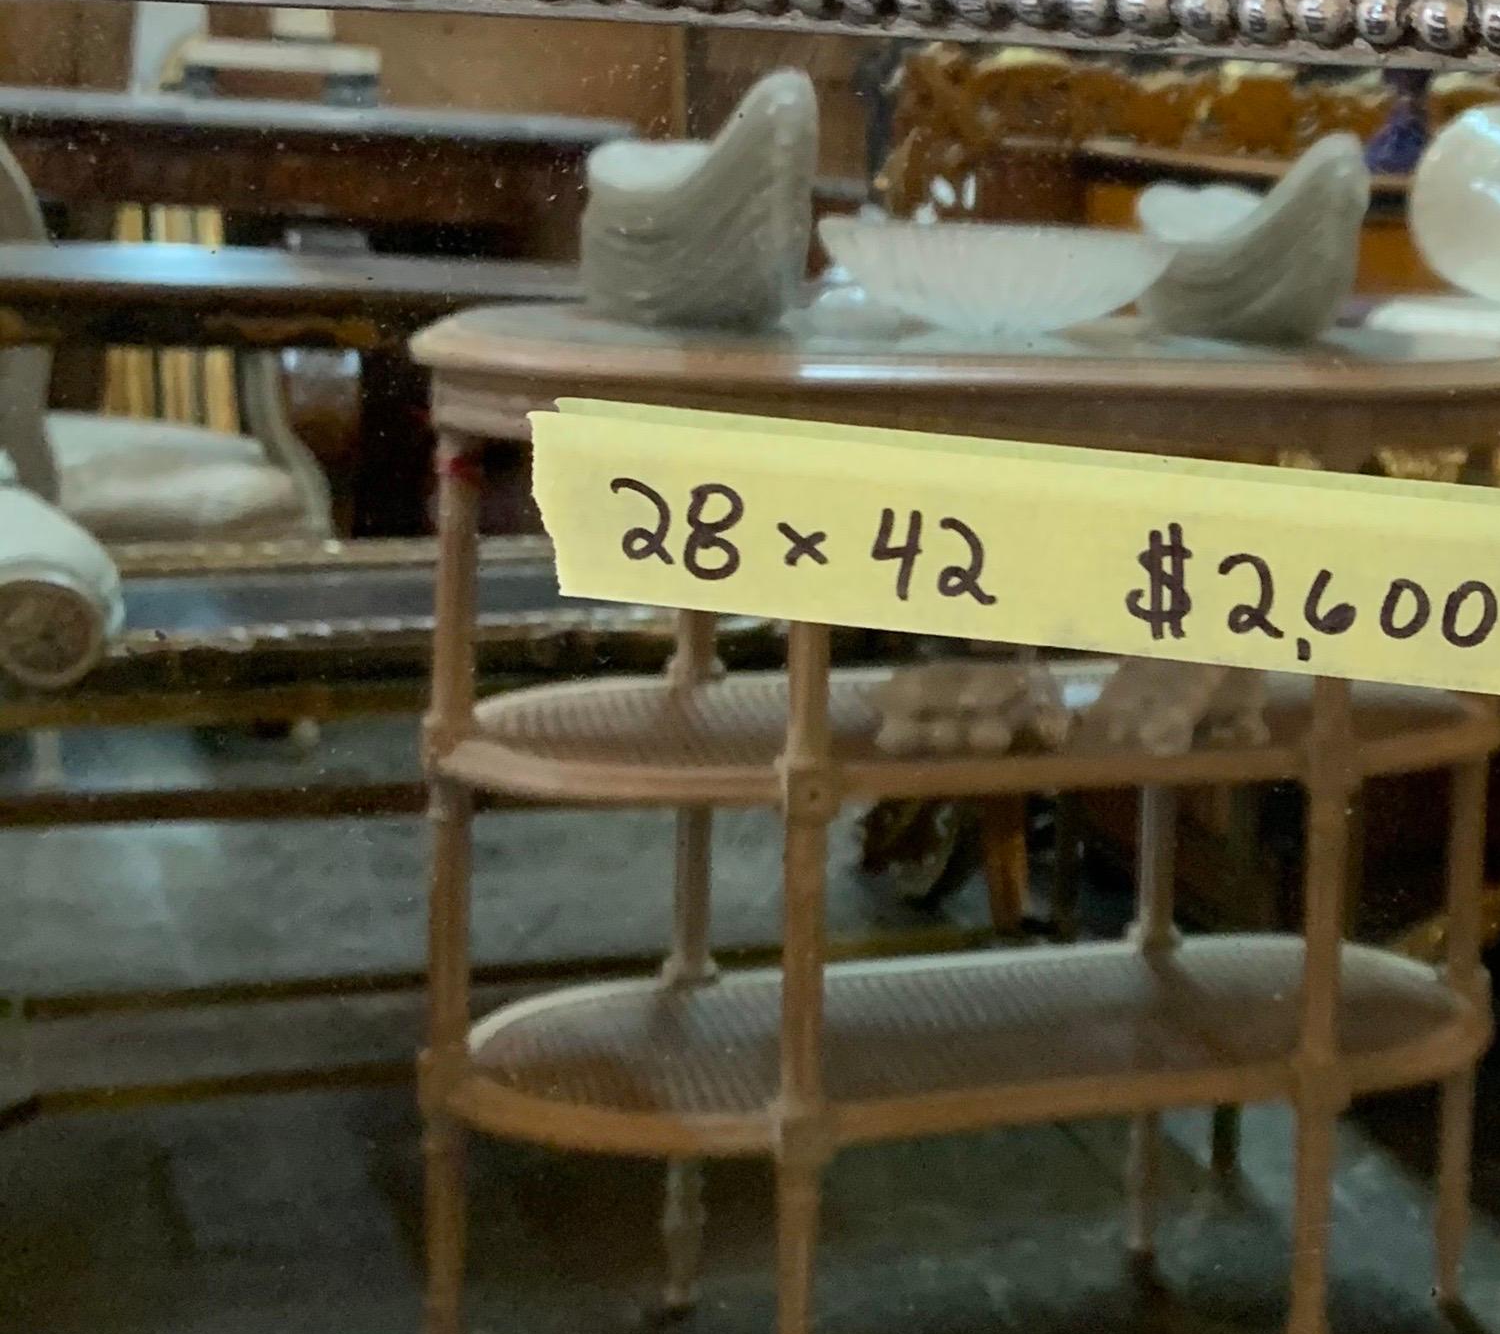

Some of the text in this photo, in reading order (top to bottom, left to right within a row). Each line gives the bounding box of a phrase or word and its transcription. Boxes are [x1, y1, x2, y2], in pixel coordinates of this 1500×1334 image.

[609, 476, 1499, 663] 28 x 42 $2,600
